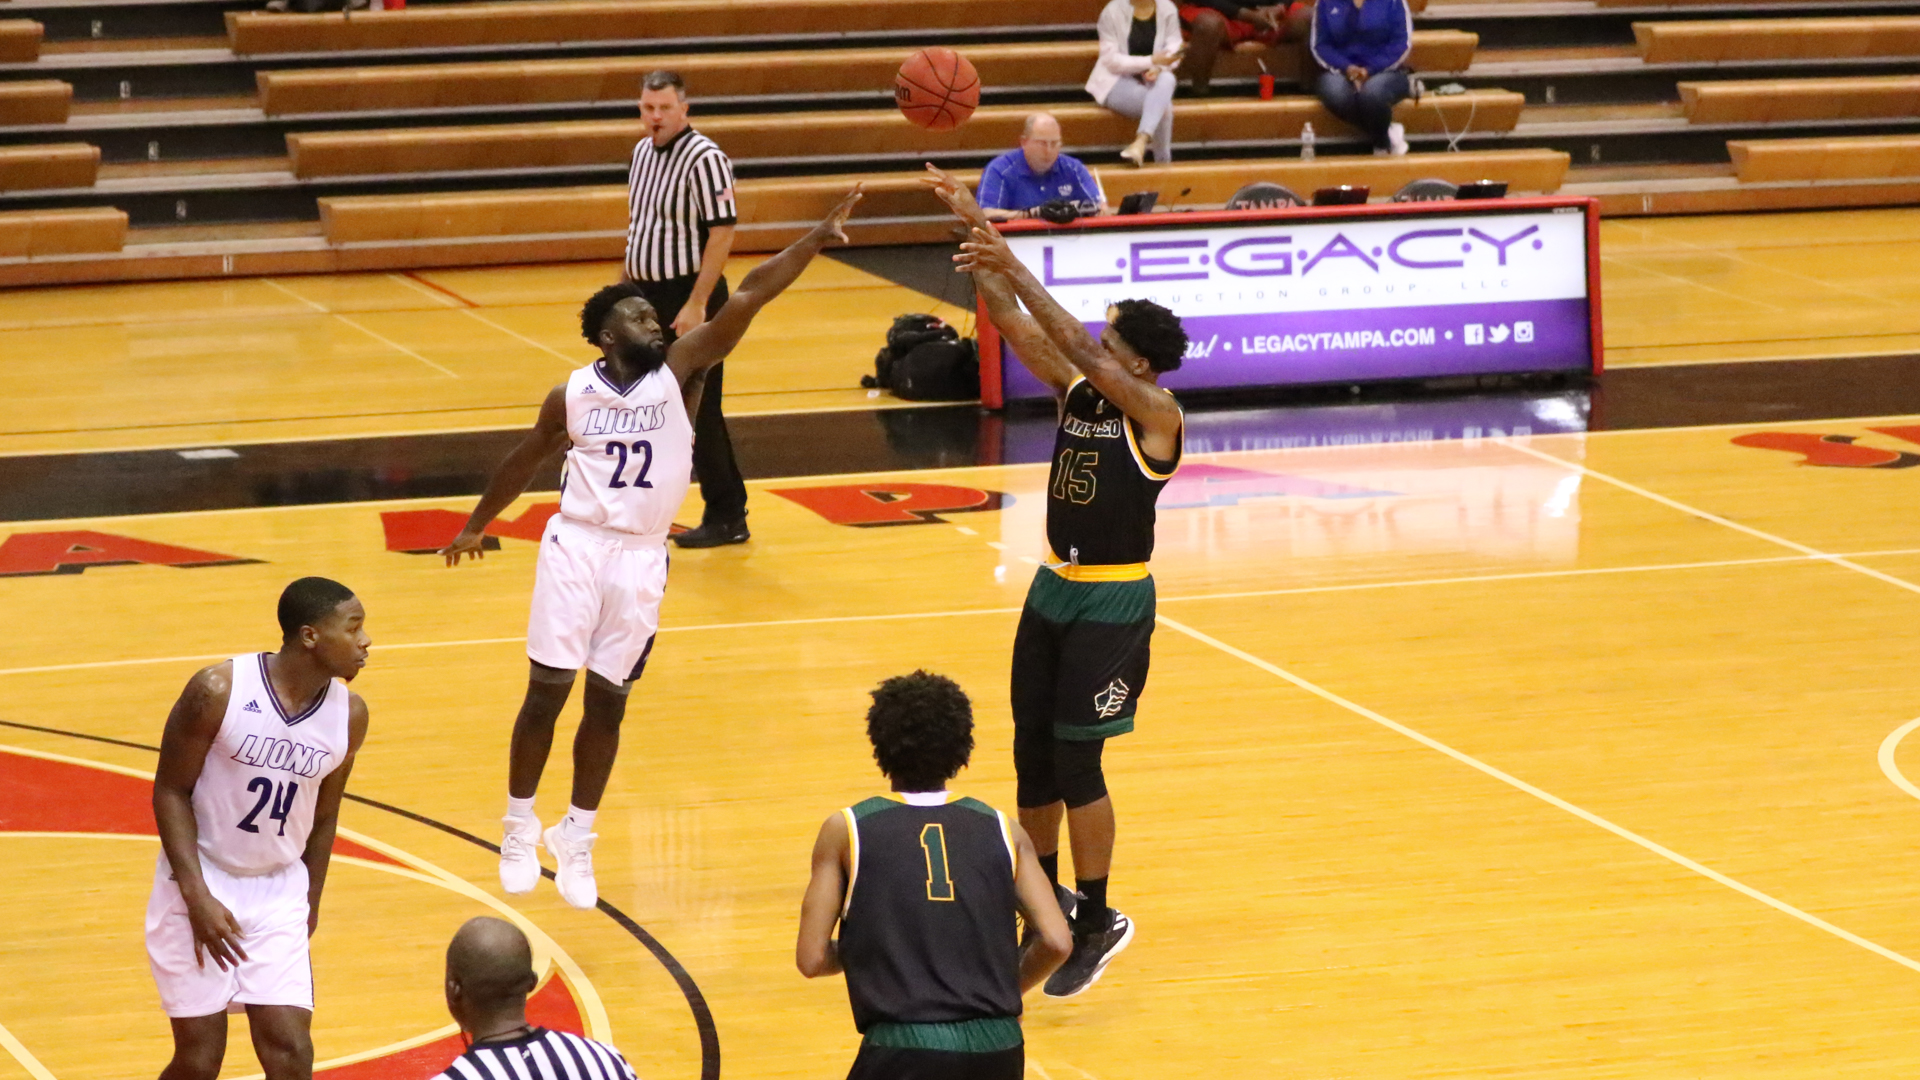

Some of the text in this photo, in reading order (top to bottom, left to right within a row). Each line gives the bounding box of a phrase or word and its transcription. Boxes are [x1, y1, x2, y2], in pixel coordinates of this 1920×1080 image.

[1081, 290, 1288, 307] PRDUCTION
[1461, 279, 1509, 290] LLC
[1242, 327, 1435, 354] LEGACYTAMPA.COM
[582, 400, 668, 436] LIONS
[605, 440, 654, 489] 22
[1053, 448, 1098, 505] 15
[230, 734, 330, 779] LIONS
[236, 776, 299, 836] 24
[920, 823, 955, 901] 1
